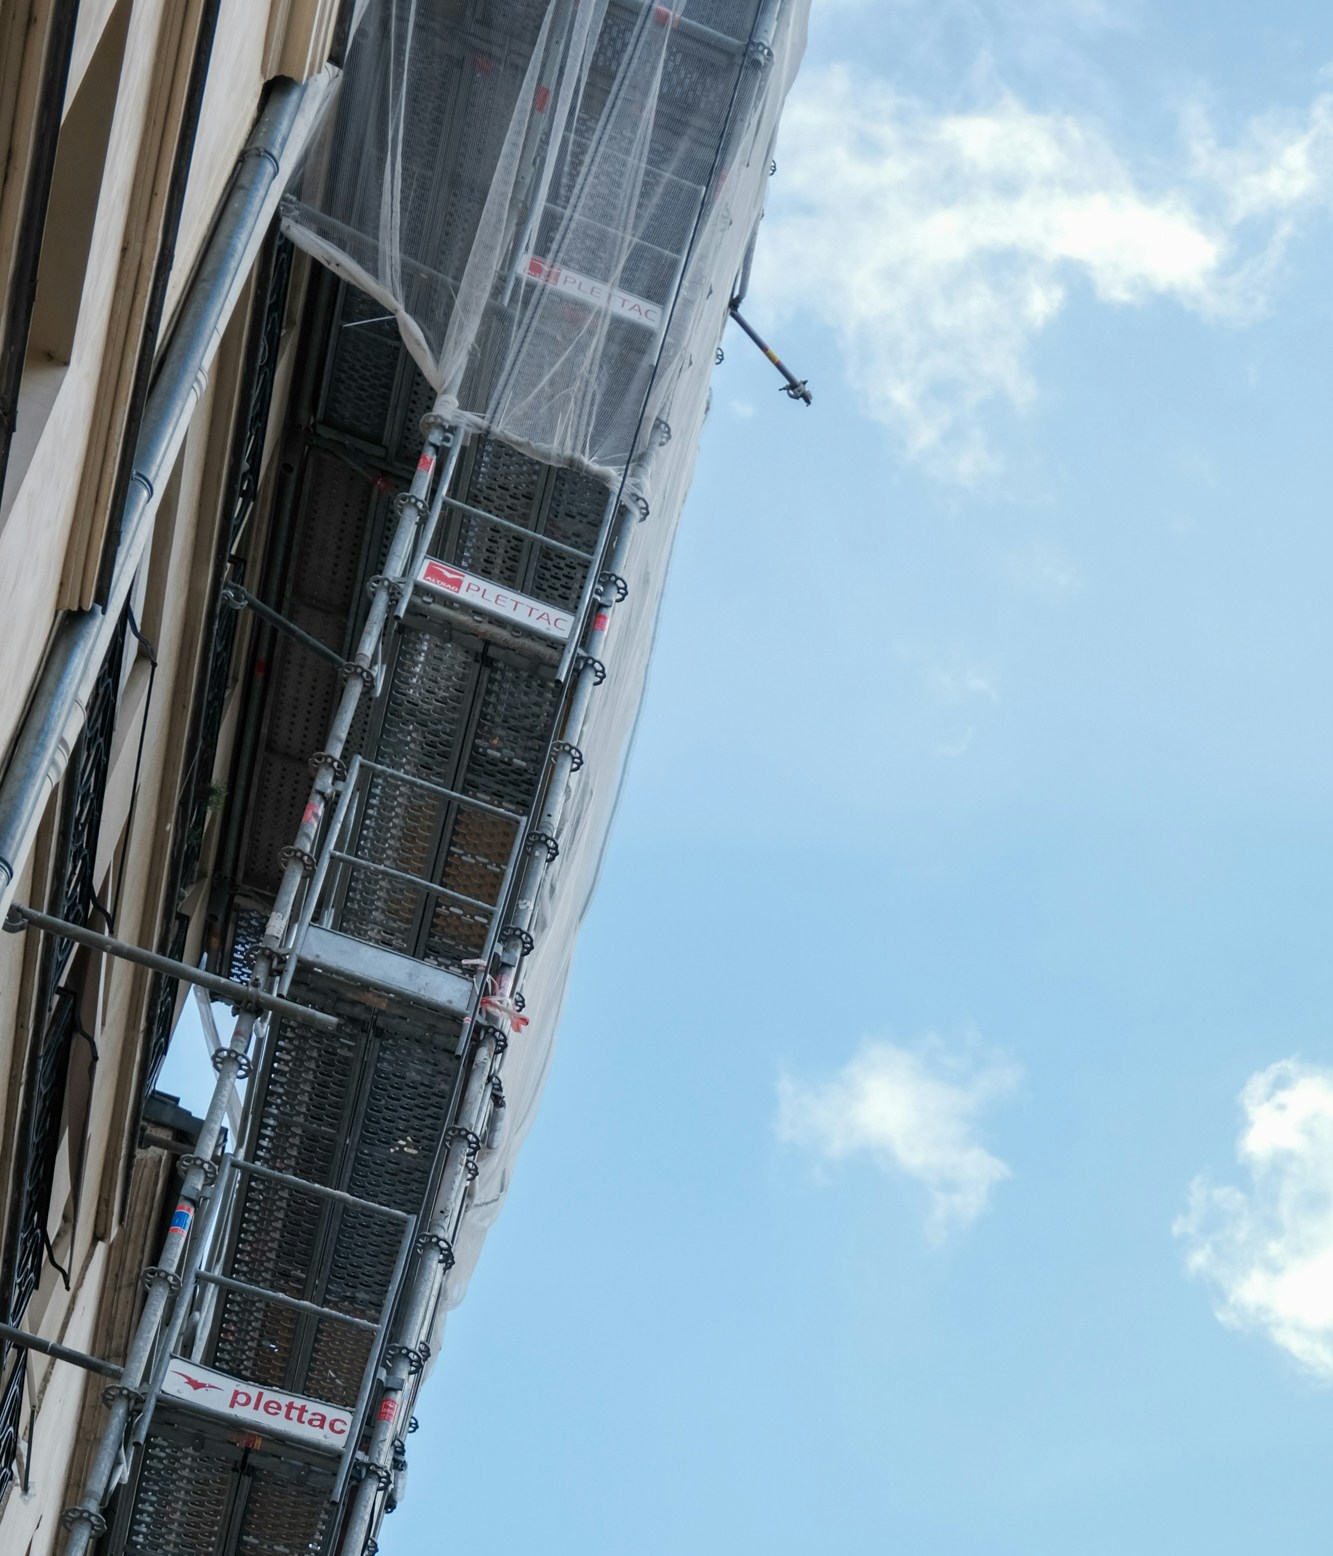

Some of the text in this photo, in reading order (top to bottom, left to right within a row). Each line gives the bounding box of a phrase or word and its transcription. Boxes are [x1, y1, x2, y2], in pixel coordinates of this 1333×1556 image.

[562, 274, 658, 323] PLETTAC
[425, 575, 459, 592] ALTRAD
[465, 582, 568, 631] PLETTAC
[228, 1389, 348, 1435] plettac
